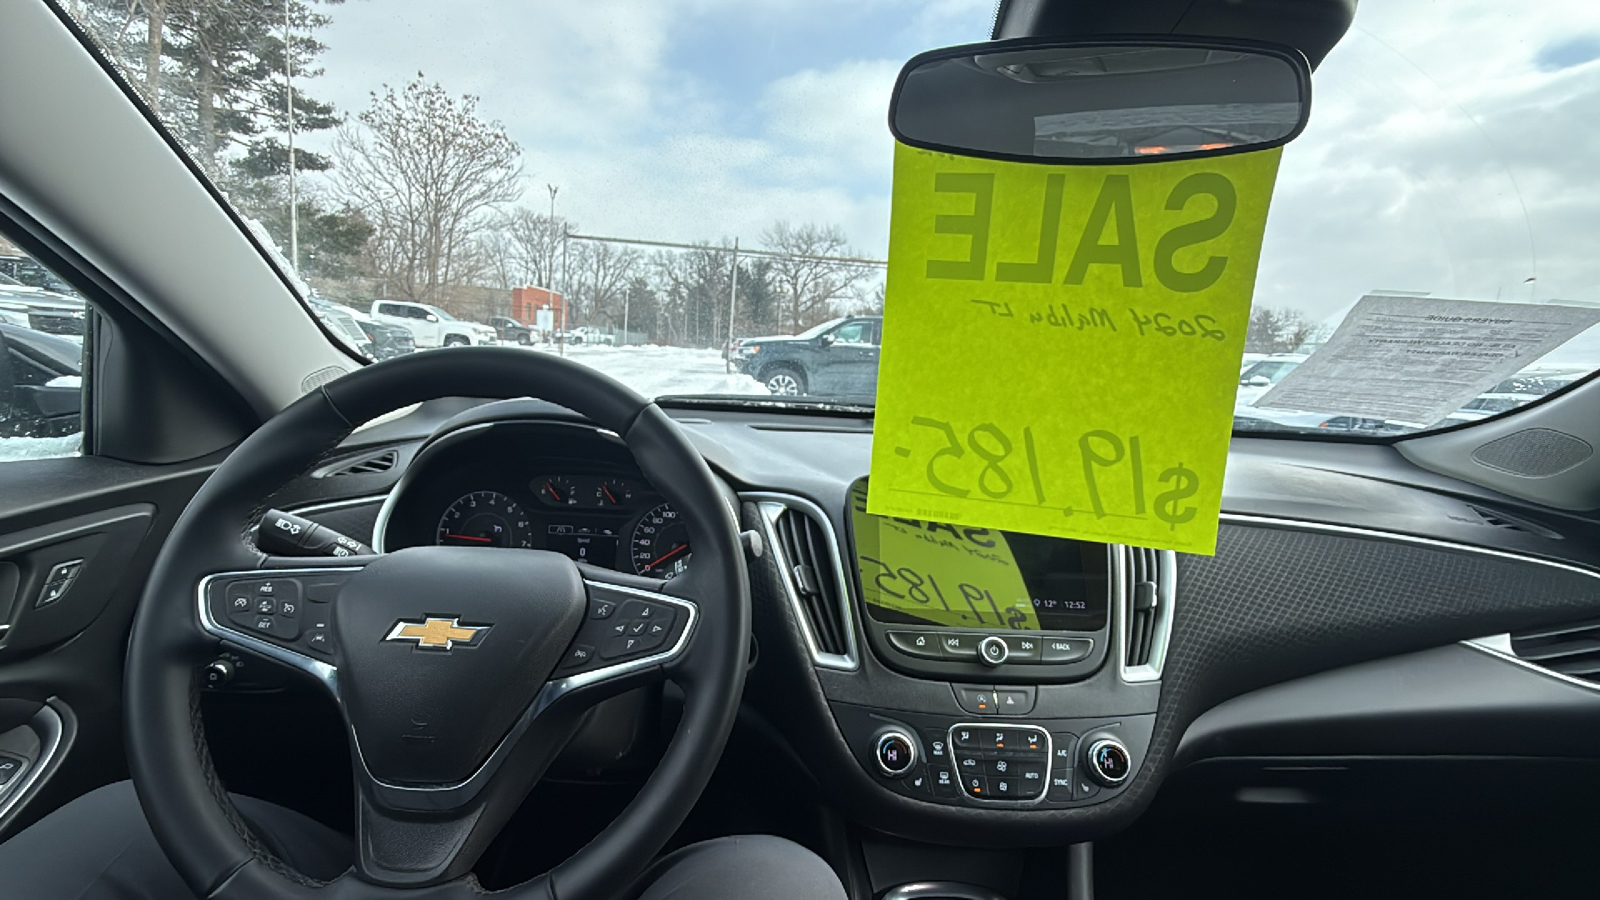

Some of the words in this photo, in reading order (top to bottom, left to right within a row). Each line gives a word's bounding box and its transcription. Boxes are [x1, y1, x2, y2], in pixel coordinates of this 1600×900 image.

[1064, 601, 1086, 609] 12:52
[887, 749, 898, 761] HI
[1053, 778, 1068, 786] SYNC
